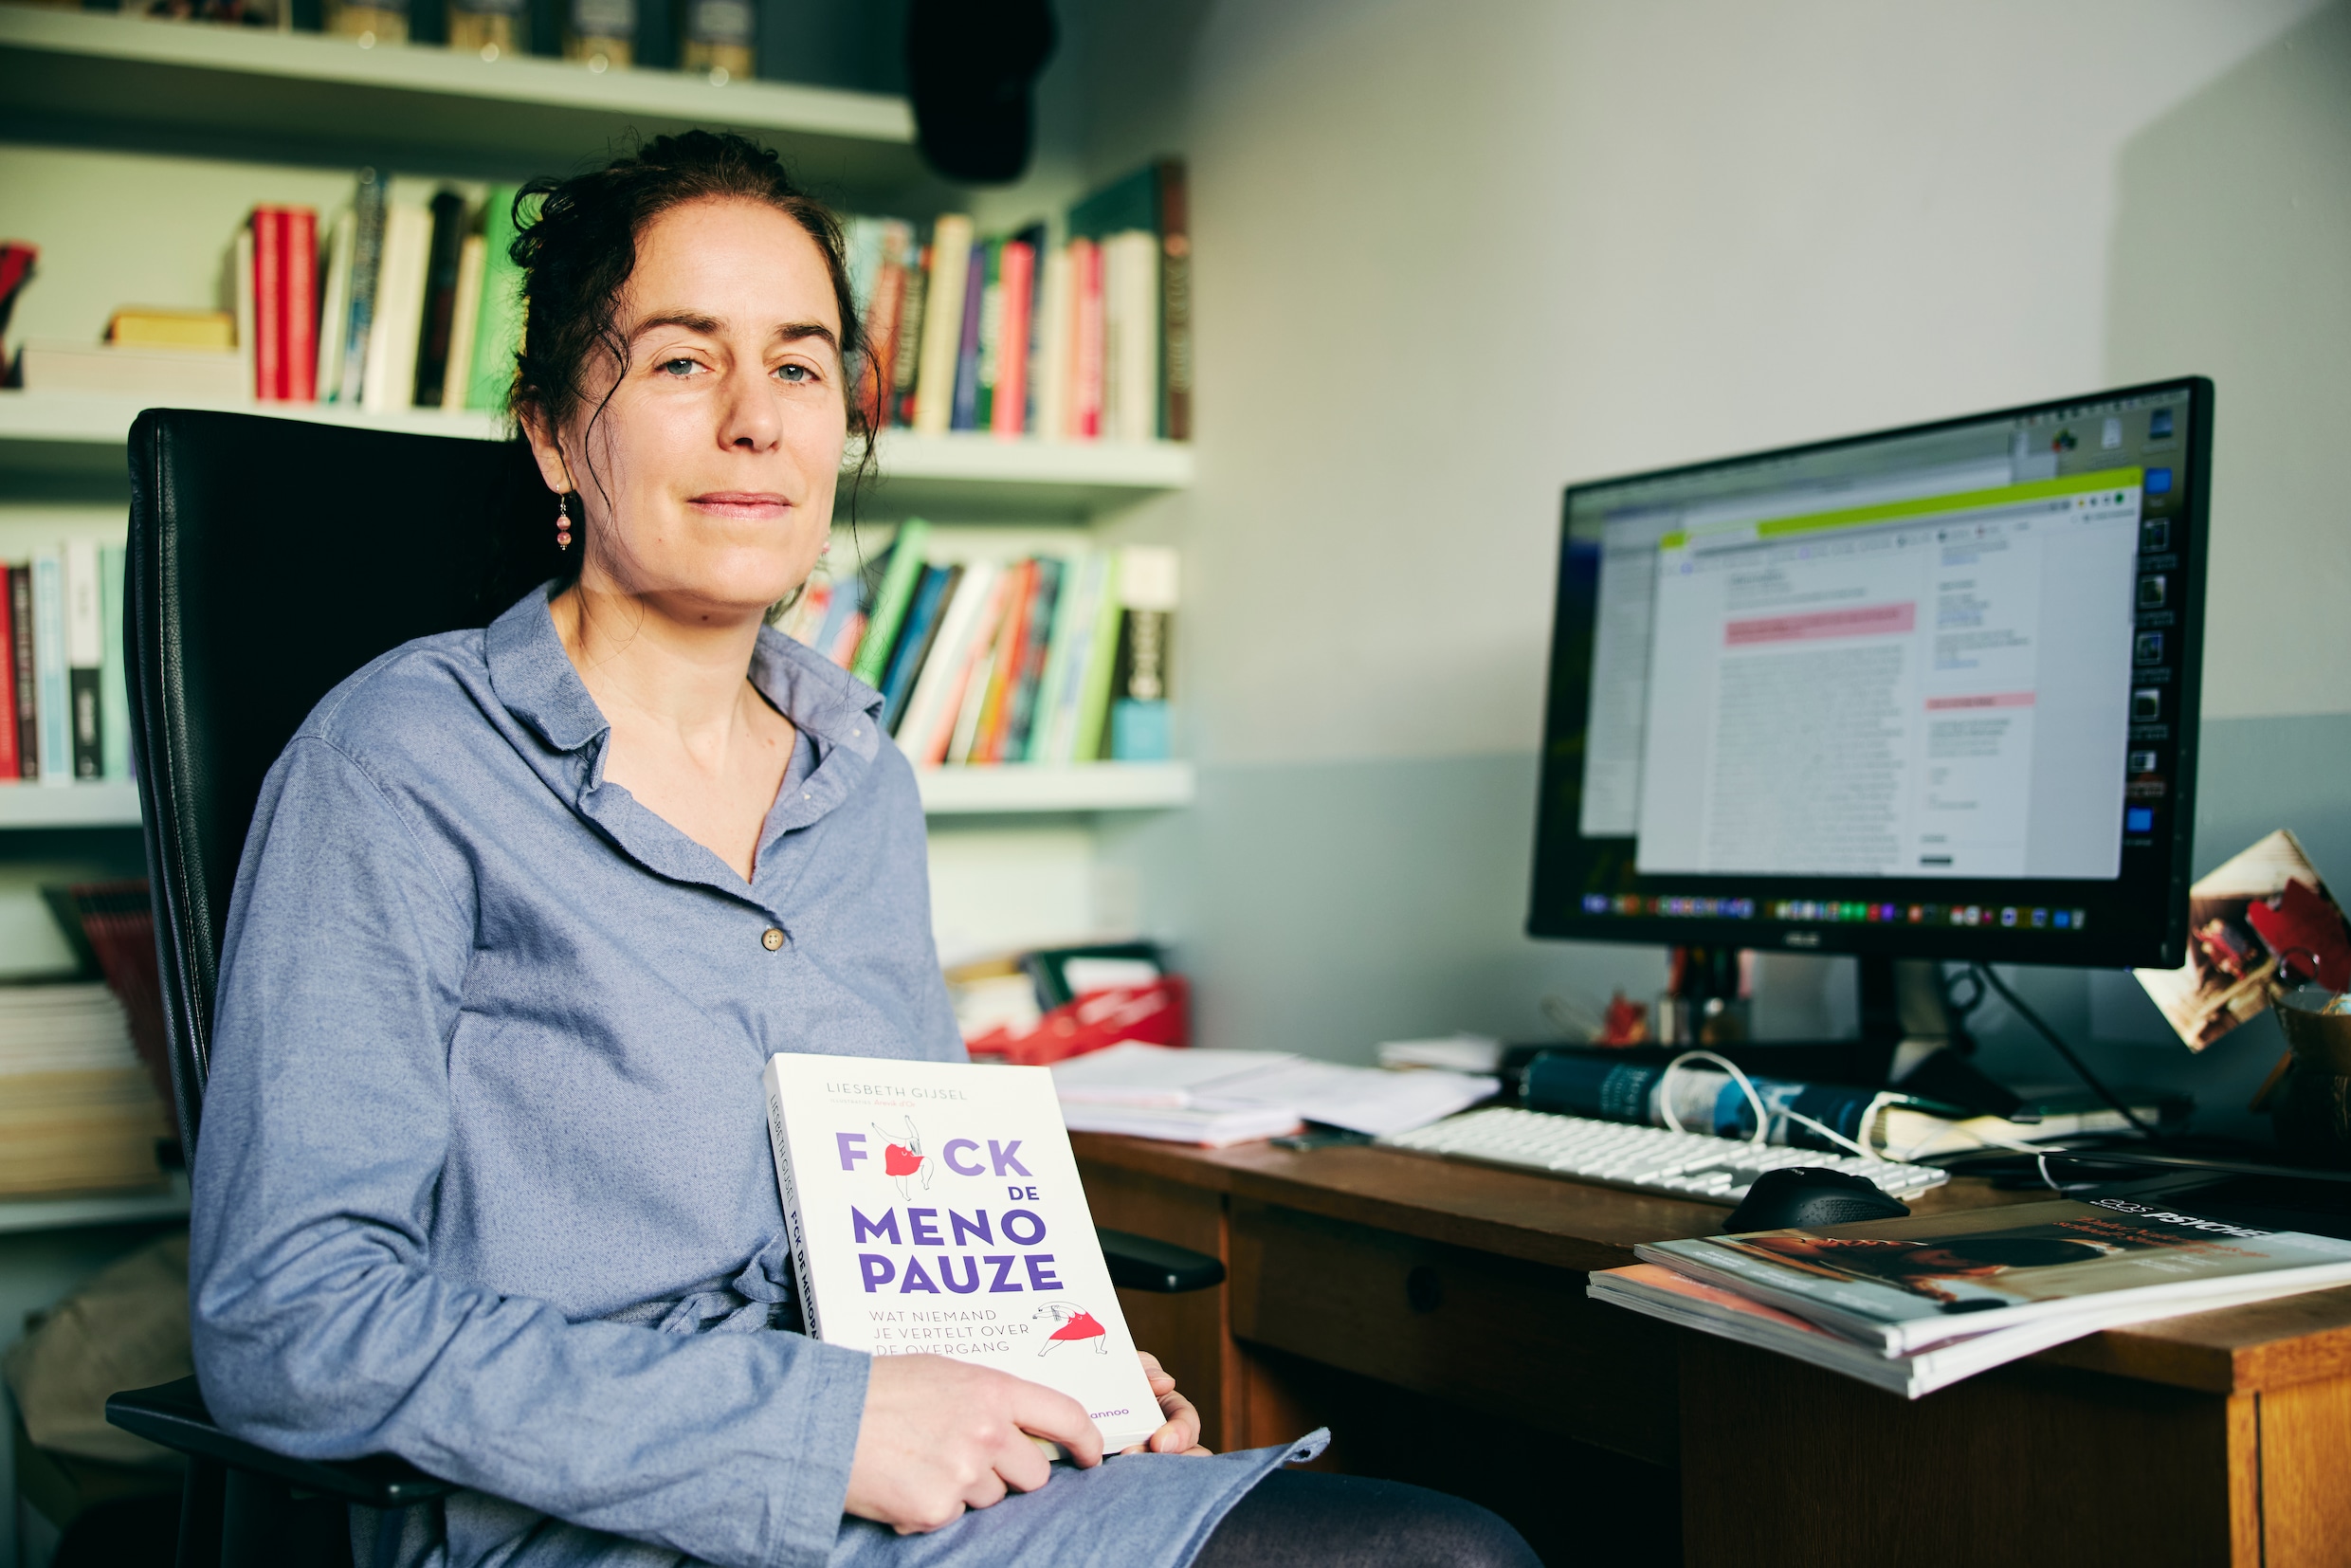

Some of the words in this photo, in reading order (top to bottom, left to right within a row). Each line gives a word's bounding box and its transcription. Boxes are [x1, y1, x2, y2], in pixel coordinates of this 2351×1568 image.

[827, 1083, 905, 1097] LIESBETH
[911, 1087, 968, 1101] GIJSEL
[874, 1099, 897, 1107] Arevik
[1007, 1186, 1040, 1200] DE
[770, 1094, 786, 1158] LIESBETH
[781, 1158, 794, 1208] GIJSEL
[797, 1249, 806, 1272] DE
[802, 1273, 819, 1340] MENOPA
[850, 1204, 1047, 1247] MENO
[858, 1253, 1064, 1294] PAUZE
[869, 1310, 905, 1322] WAT
[912, 1310, 996, 1322] NIEMAND
[874, 1328, 892, 1339] JE
[898, 1326, 974, 1340] VERTELT
[980, 1323, 1030, 1337] OVER
[905, 1340, 1010, 1356] OVERGANG
[1090, 1409, 1130, 1419] annoo
